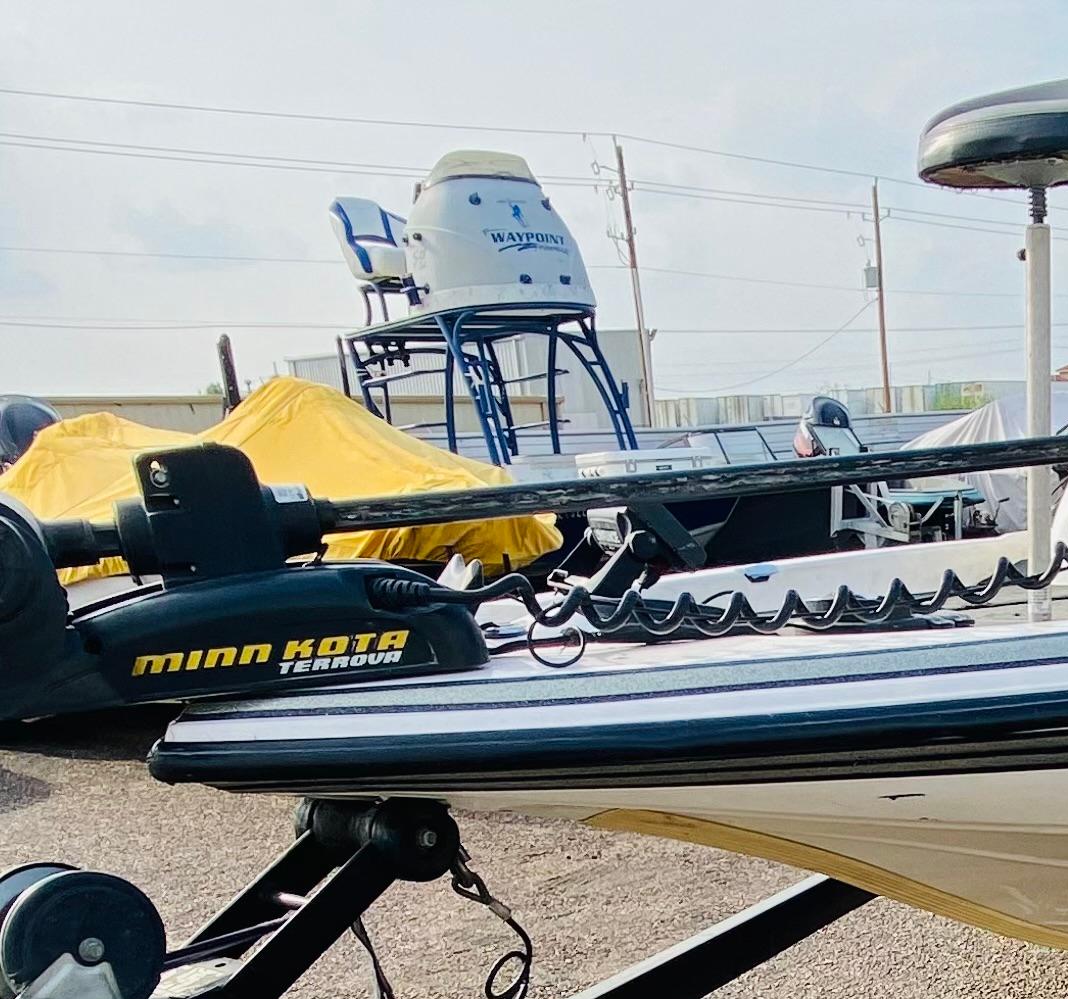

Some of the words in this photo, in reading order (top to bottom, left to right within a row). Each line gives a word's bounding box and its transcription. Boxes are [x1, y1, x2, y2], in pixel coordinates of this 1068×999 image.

[491, 232, 565, 246] WAYPOINT
[282, 629, 410, 661] KOTA
[278, 650, 403, 675] TERROVA
